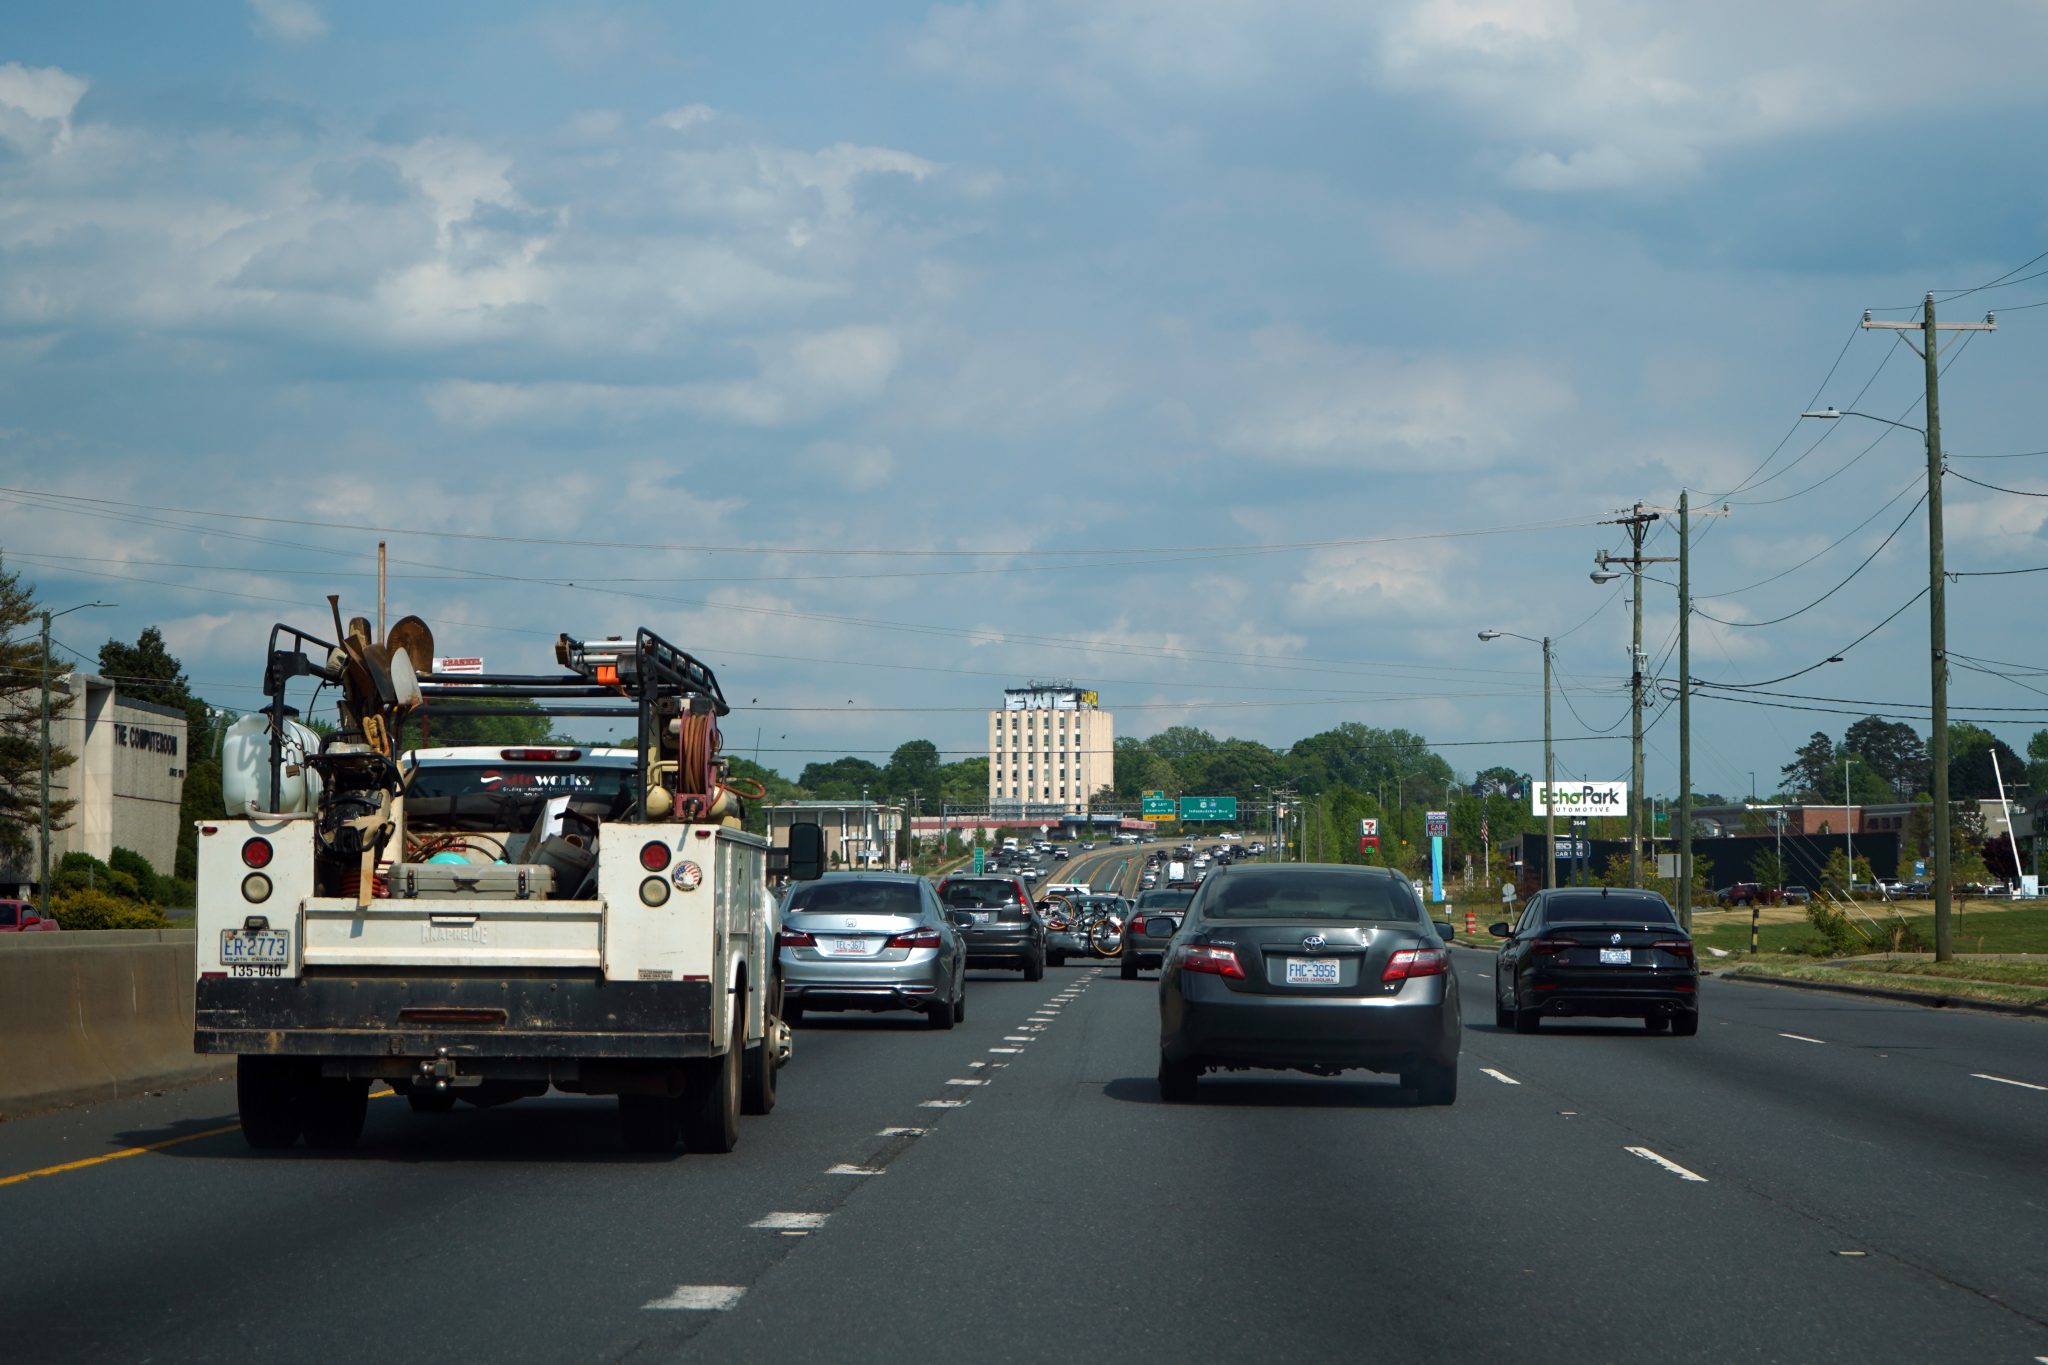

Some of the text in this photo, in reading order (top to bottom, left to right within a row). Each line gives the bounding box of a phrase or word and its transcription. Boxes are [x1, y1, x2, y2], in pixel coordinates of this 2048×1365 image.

[114, 723, 128, 747] THE
[1539, 785, 1619, 805] EchoPark
[224, 938, 285, 956] ER-2773
[231, 964, 281, 977] 135-040
[1289, 963, 1337, 978] FHC-3956
